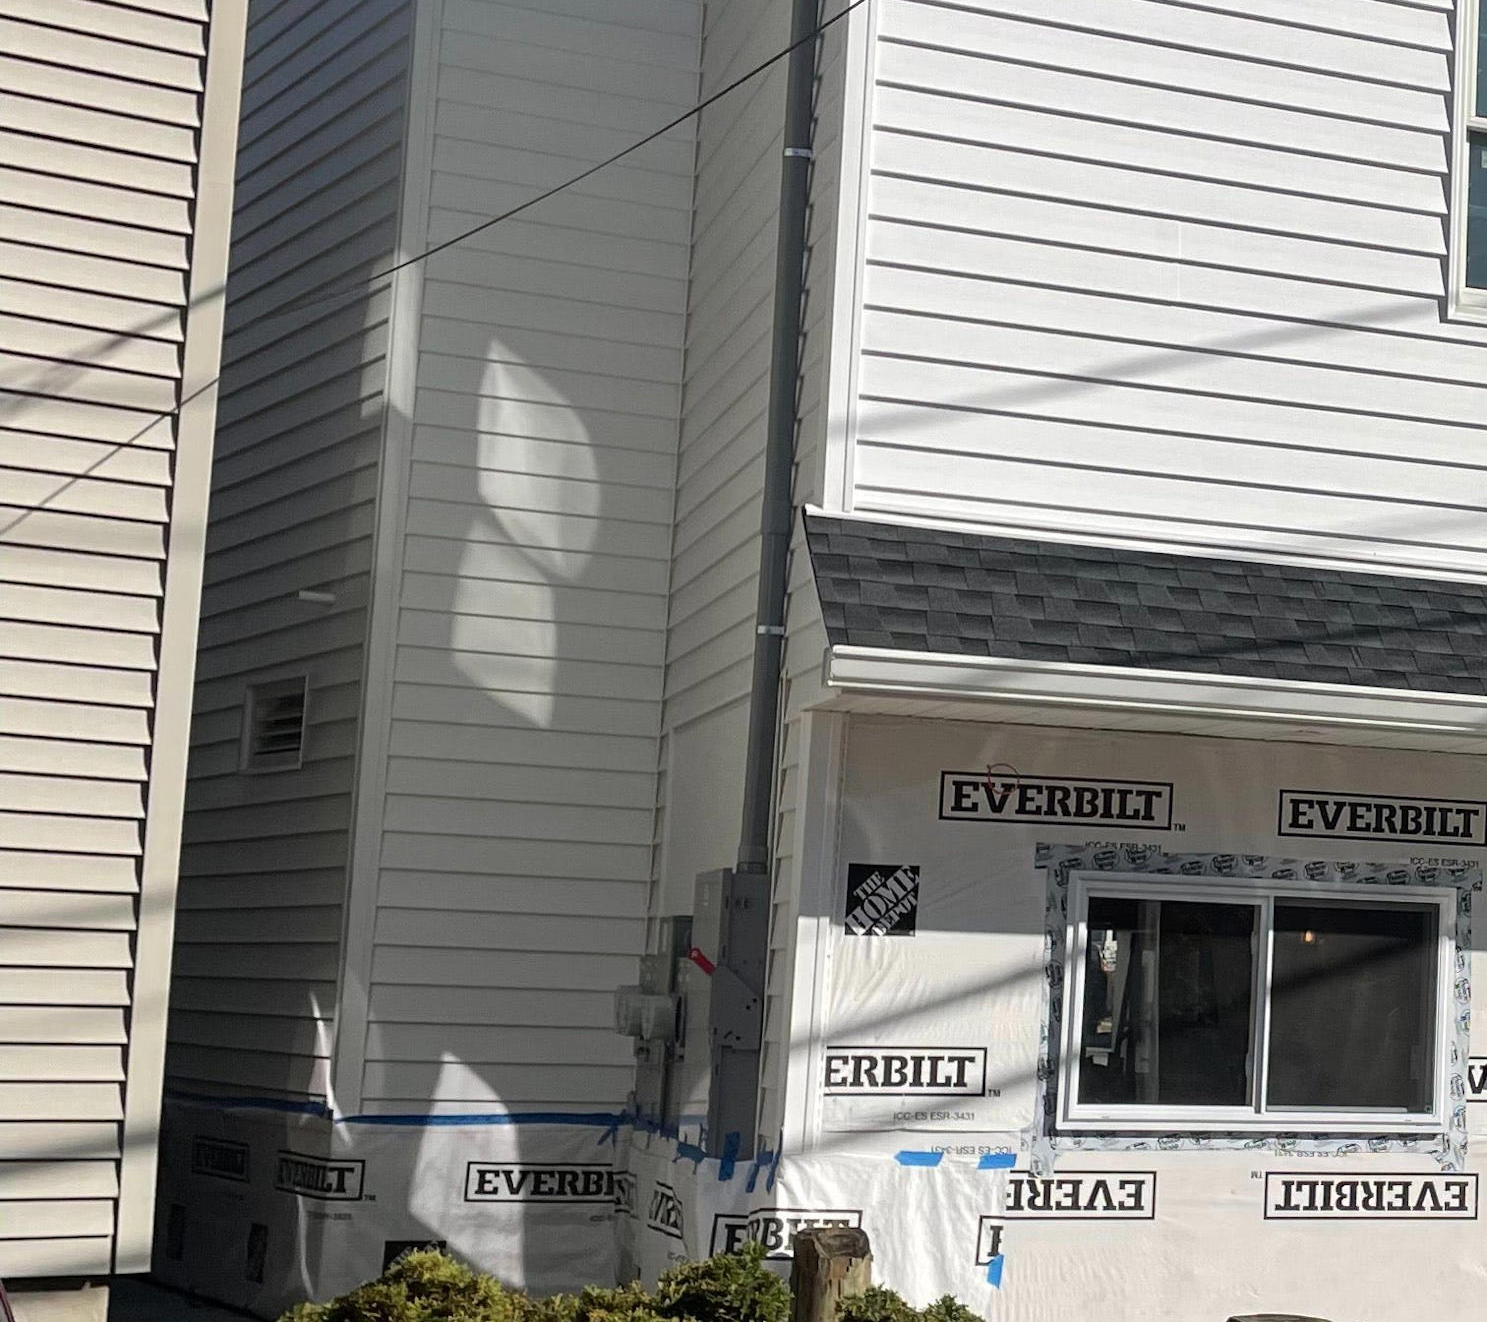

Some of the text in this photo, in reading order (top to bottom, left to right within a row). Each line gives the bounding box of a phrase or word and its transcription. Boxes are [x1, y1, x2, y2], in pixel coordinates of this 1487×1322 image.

[951, 781, 1162, 820] EVERBILT
[1288, 798, 1479, 838] EVERBILT
[846, 865, 919, 936] HOME
[853, 871, 885, 900] THE
[871, 892, 918, 936] DEPOT
[1275, 1180, 1469, 1212] EVERBILT
